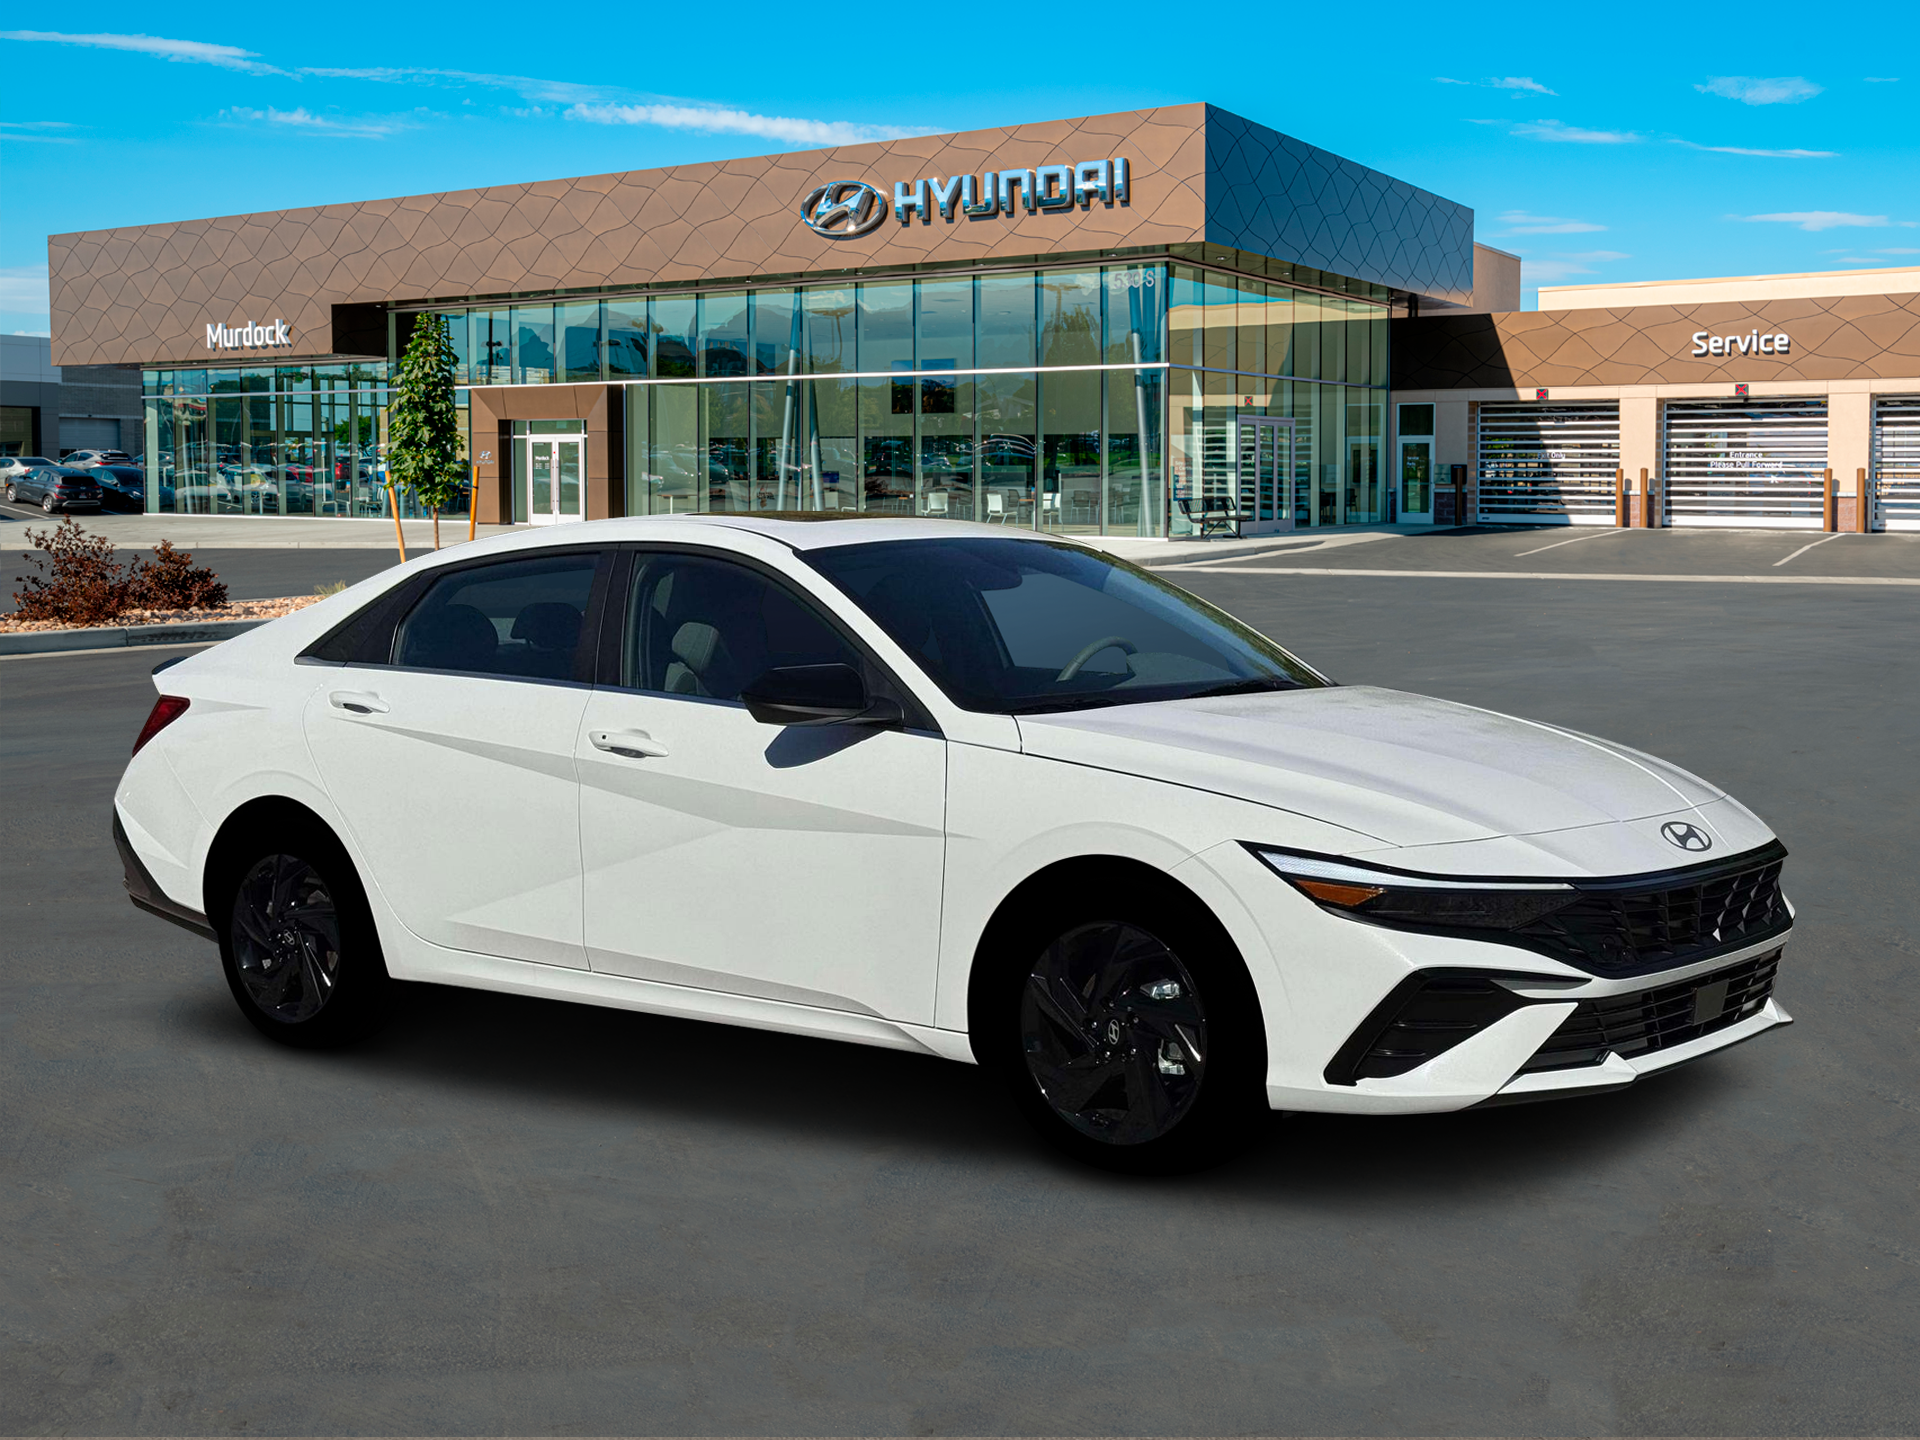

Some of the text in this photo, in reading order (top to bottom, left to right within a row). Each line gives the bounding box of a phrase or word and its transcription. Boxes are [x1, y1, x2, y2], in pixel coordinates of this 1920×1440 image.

[895, 157, 1129, 224] HYUNDAI
[1114, 270, 1155, 289] 530 S
[206, 318, 291, 349] Murdock
[1691, 329, 1790, 356] Service
[1551, 452, 1565, 460] Only
